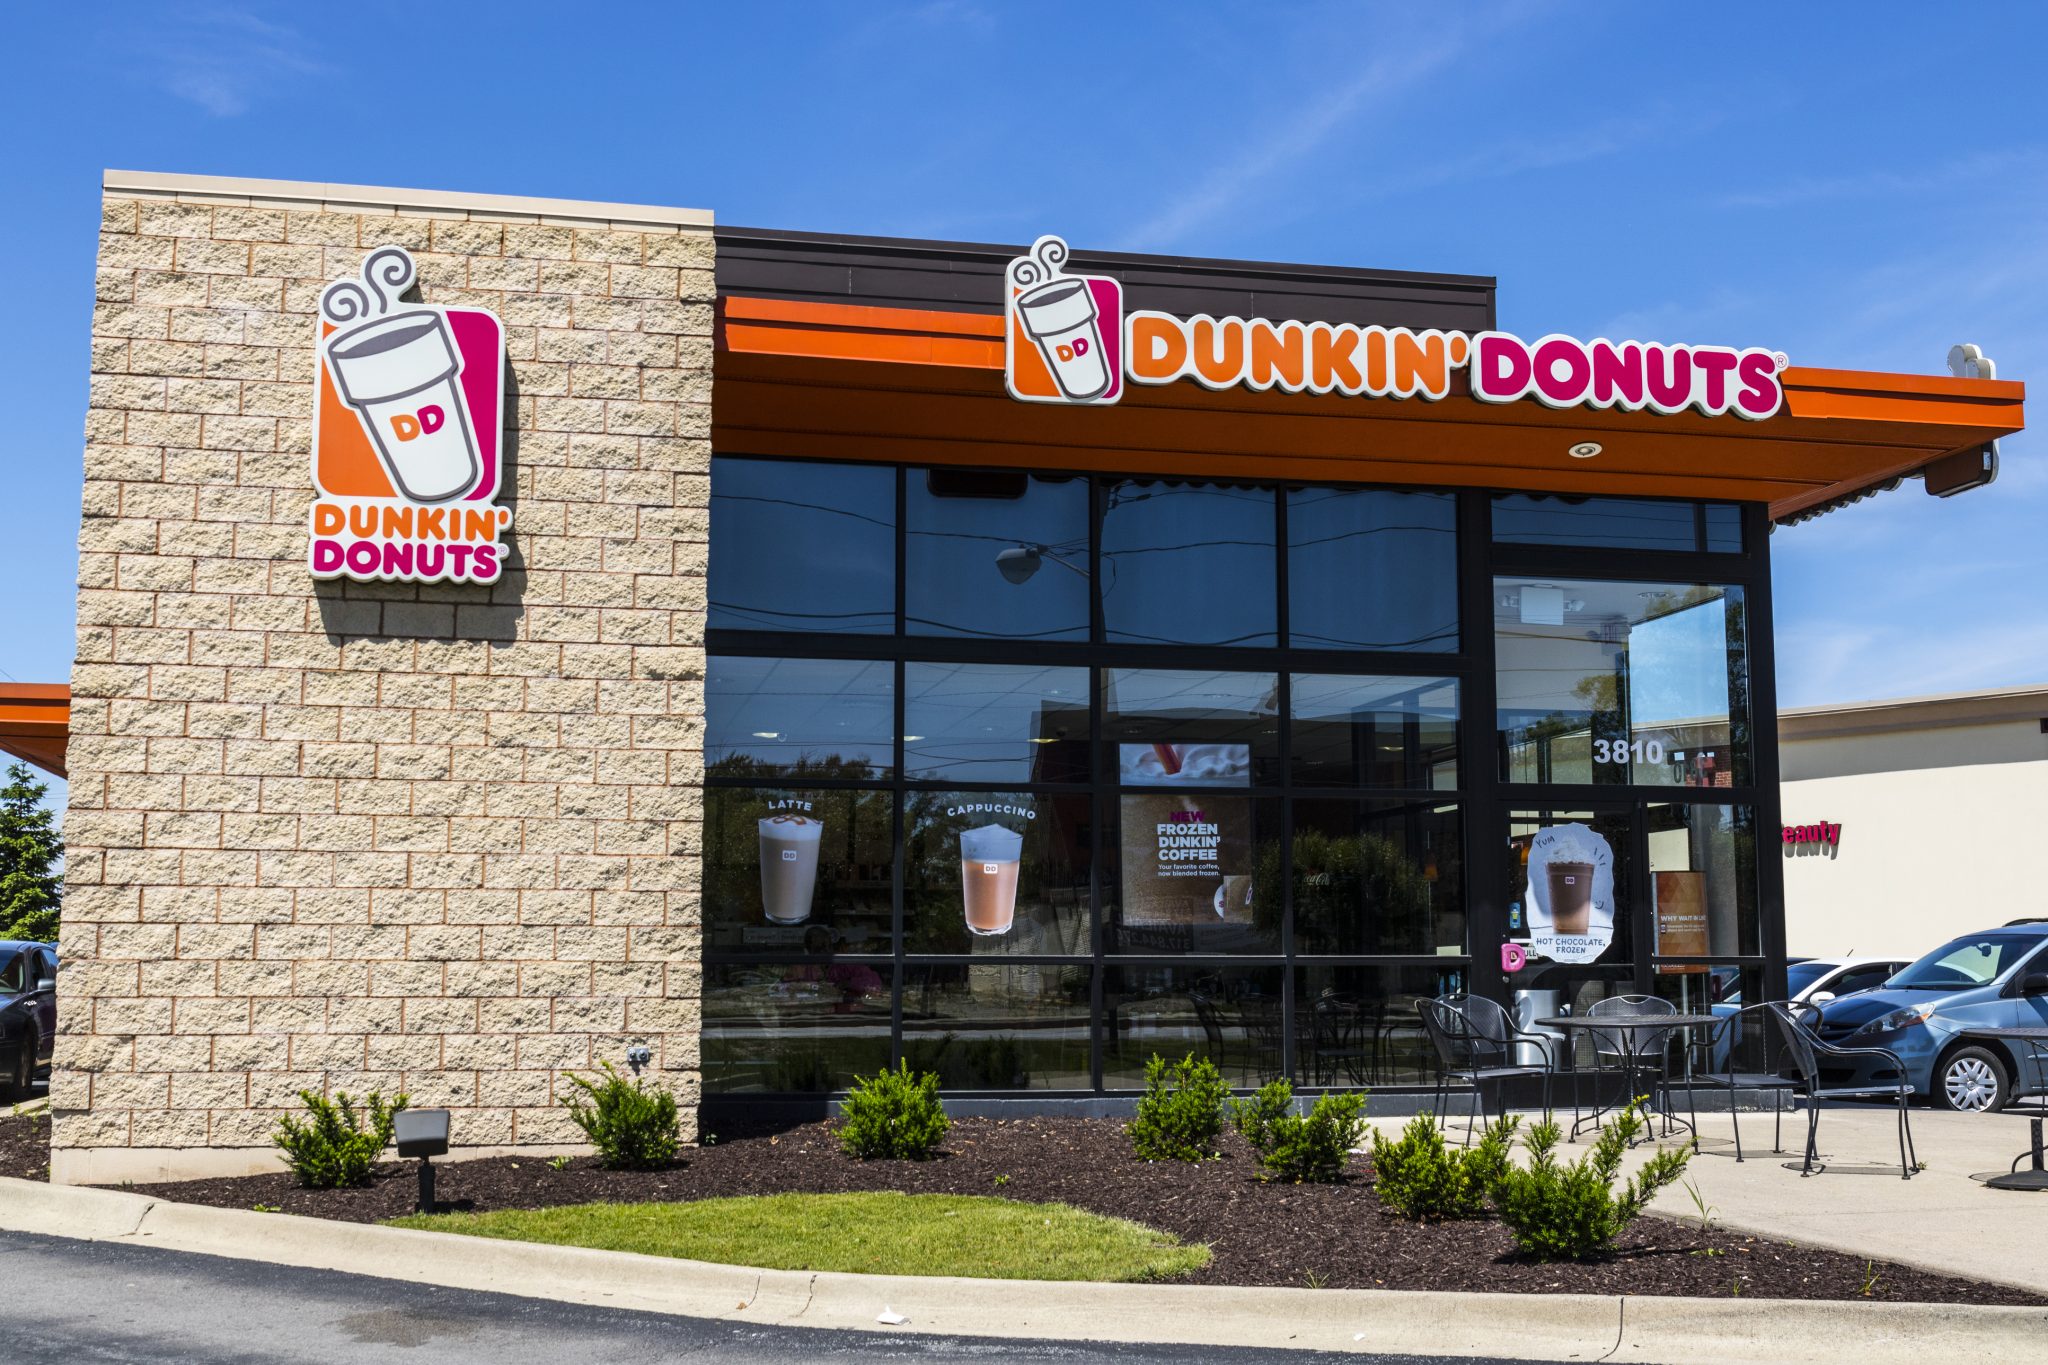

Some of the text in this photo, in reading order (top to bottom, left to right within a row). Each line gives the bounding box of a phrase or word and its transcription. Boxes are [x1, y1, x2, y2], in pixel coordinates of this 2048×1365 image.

[1055, 337, 1089, 362] DD
[1132, 316, 1467, 395] DUNKIN'
[389, 404, 445, 442] DD
[313, 503, 509, 541] DUNKIN'
[1593, 739, 1663, 764] 3810
[768, 800, 812, 811] LATTE
[947, 803, 1036, 820] CAPPUCCINO
[1170, 811, 1205, 822] NEW
[1157, 823, 1218, 835] FROZEN
[1782, 820, 1840, 845] eauty
[1158, 836, 1221, 848] DUNKIN'
[1535, 835, 1555, 848] YUM
[783, 851, 796, 859] DD
[1158, 849, 1218, 860] COFFEE
[984, 865, 997, 873] DD
[1555, 938, 1606, 947] CHOCOLATE,
[1524, 949, 1537, 957] ULL
[1556, 946, 1587, 954] FROZEN
